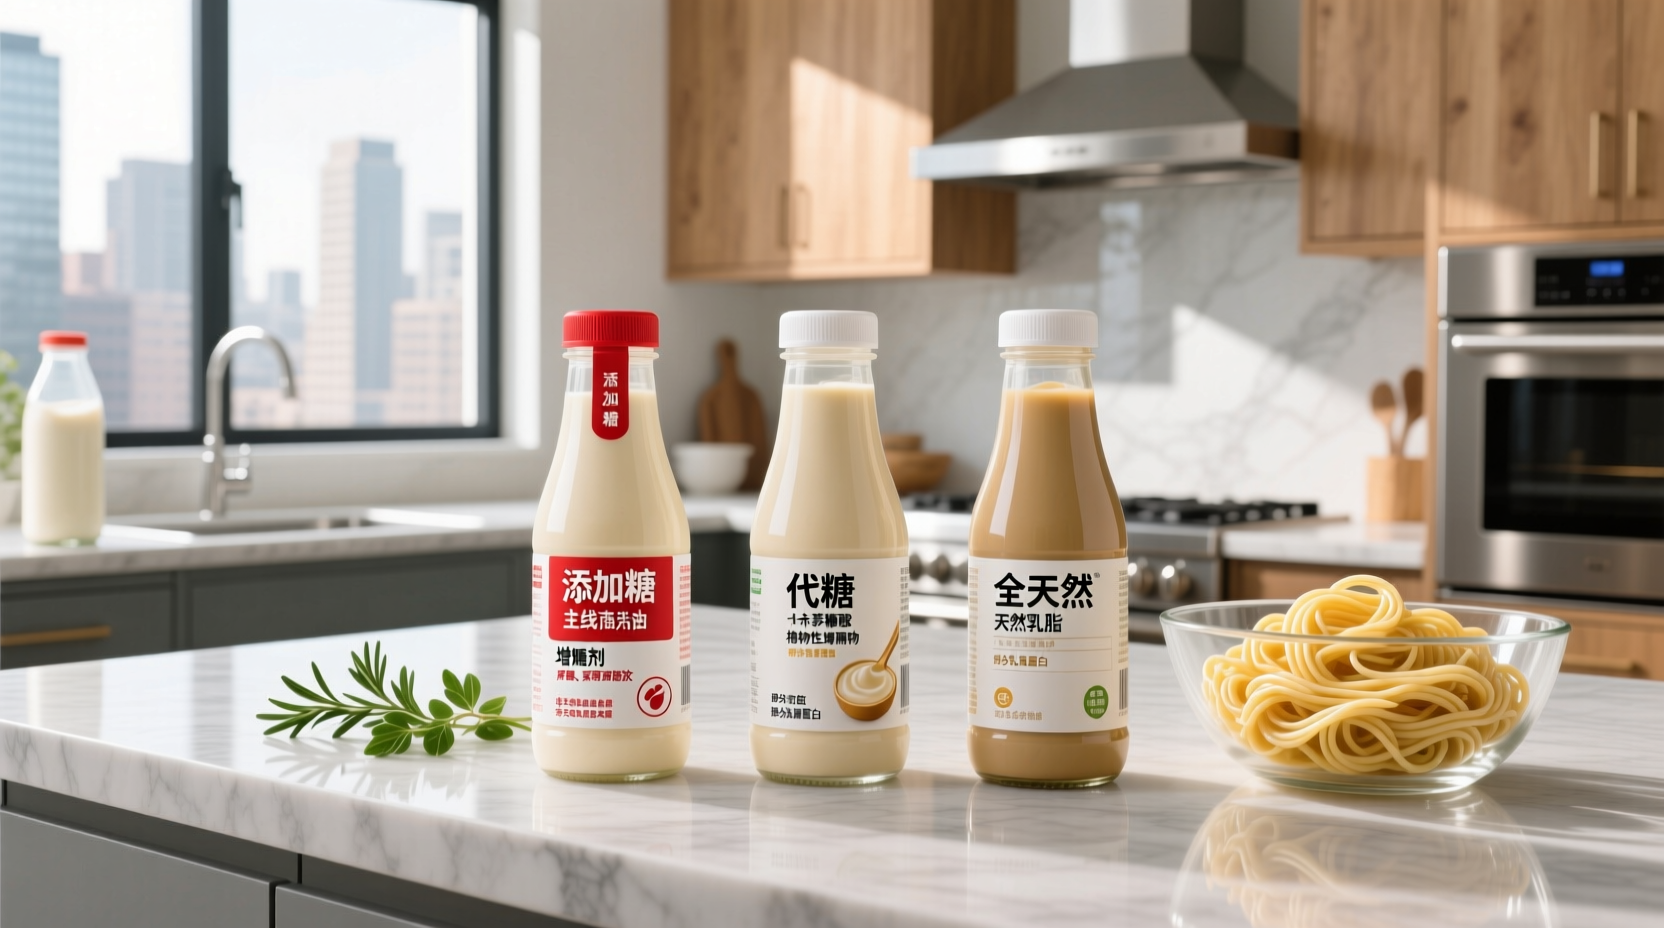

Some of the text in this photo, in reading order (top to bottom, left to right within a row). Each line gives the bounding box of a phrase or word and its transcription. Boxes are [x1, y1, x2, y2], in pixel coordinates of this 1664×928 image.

[562, 568, 656, 604] 添加糖
[786, 572, 855, 609] 代糖
[994, 572, 1093, 609] 全天然
[994, 612, 1063, 633] 天然乳脂
